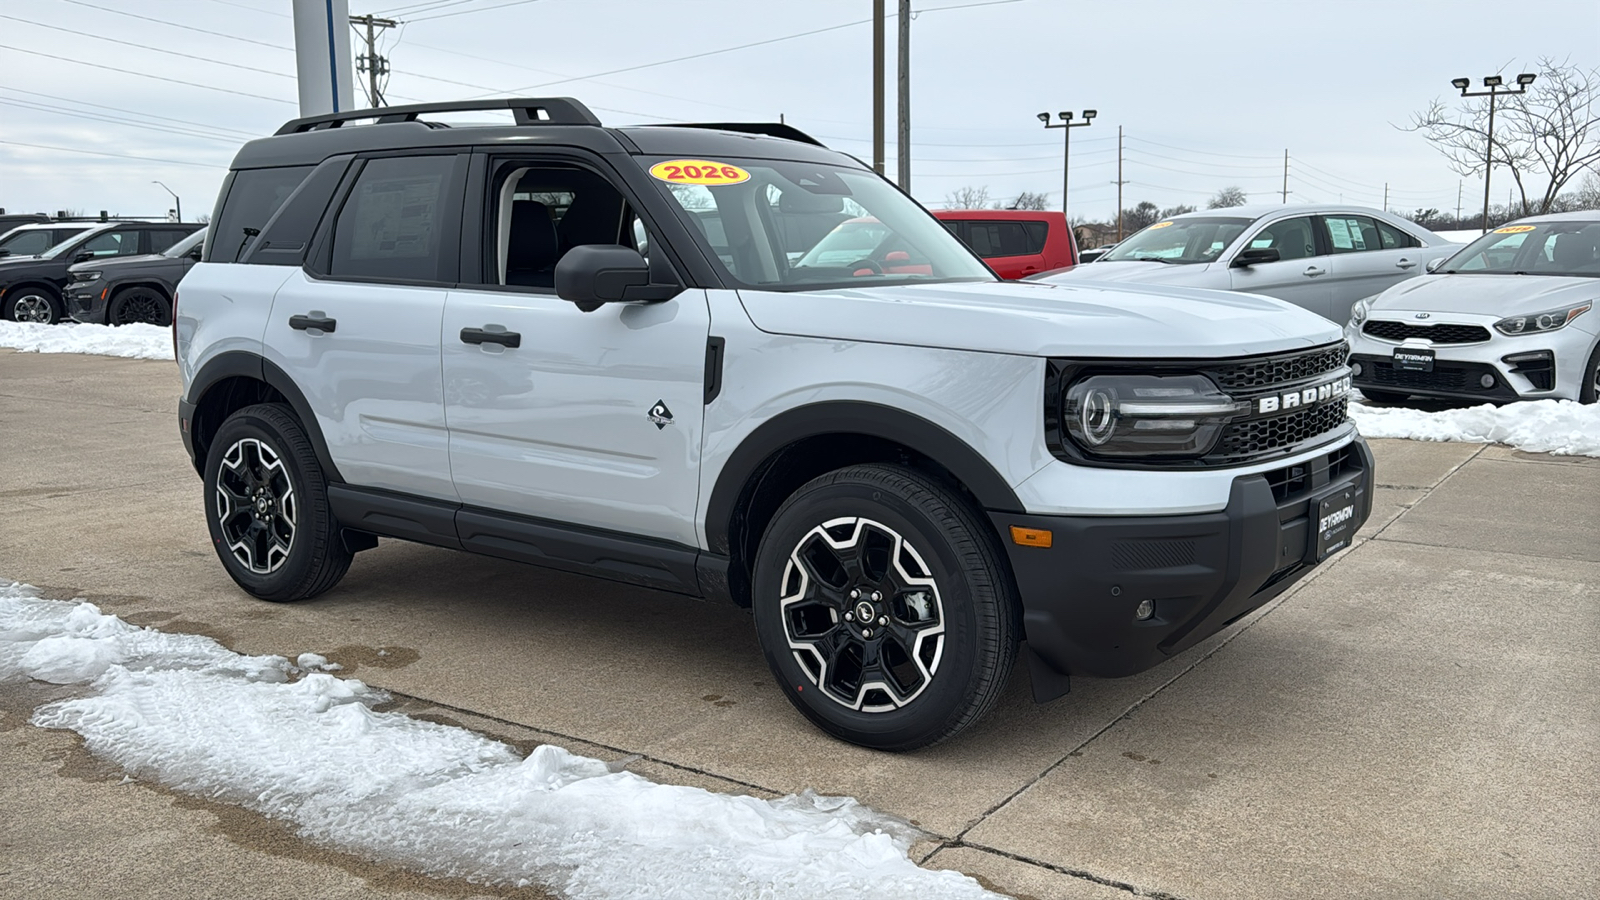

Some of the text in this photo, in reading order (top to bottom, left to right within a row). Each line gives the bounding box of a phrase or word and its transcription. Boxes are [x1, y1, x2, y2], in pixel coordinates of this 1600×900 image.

[664, 165, 740, 179] 2026
[1395, 353, 1433, 361] DEYARMAN
[1259, 377, 1351, 414] BRONCO
[1319, 504, 1354, 533] DEYARMAN
